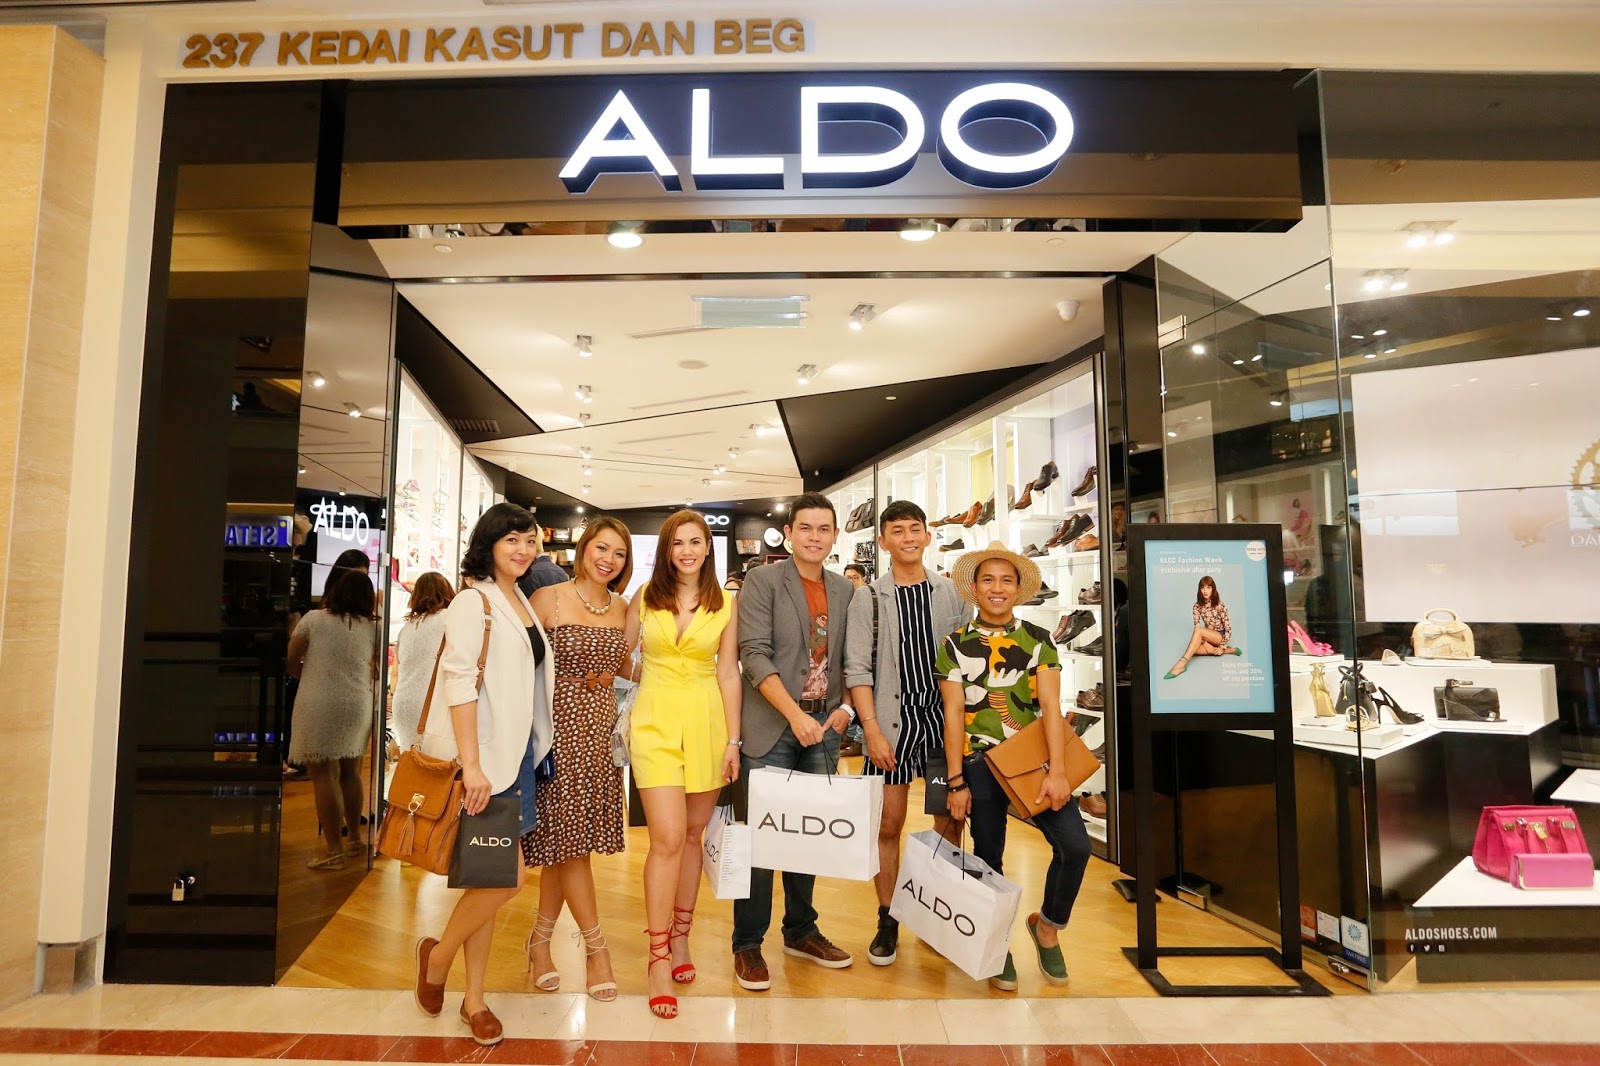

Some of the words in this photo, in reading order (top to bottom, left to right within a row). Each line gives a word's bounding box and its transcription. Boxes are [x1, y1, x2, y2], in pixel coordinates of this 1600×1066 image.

[182, 33, 264, 69] 237
[277, 29, 410, 66] KEDAI
[423, 23, 585, 62] KASUT
[601, 21, 696, 58] DAN
[713, 18, 805, 55] BEG
[558, 81, 1074, 180] ALDO
[313, 497, 370, 546] ALDO
[703, 514, 730, 526] DO
[932, 777, 947, 785] AL
[757, 811, 856, 839] ALDO
[469, 836, 512, 847] ALDO
[901, 877, 976, 937] ALDO
[1404, 926, 1498, 941] ALDOSHOES.COM
